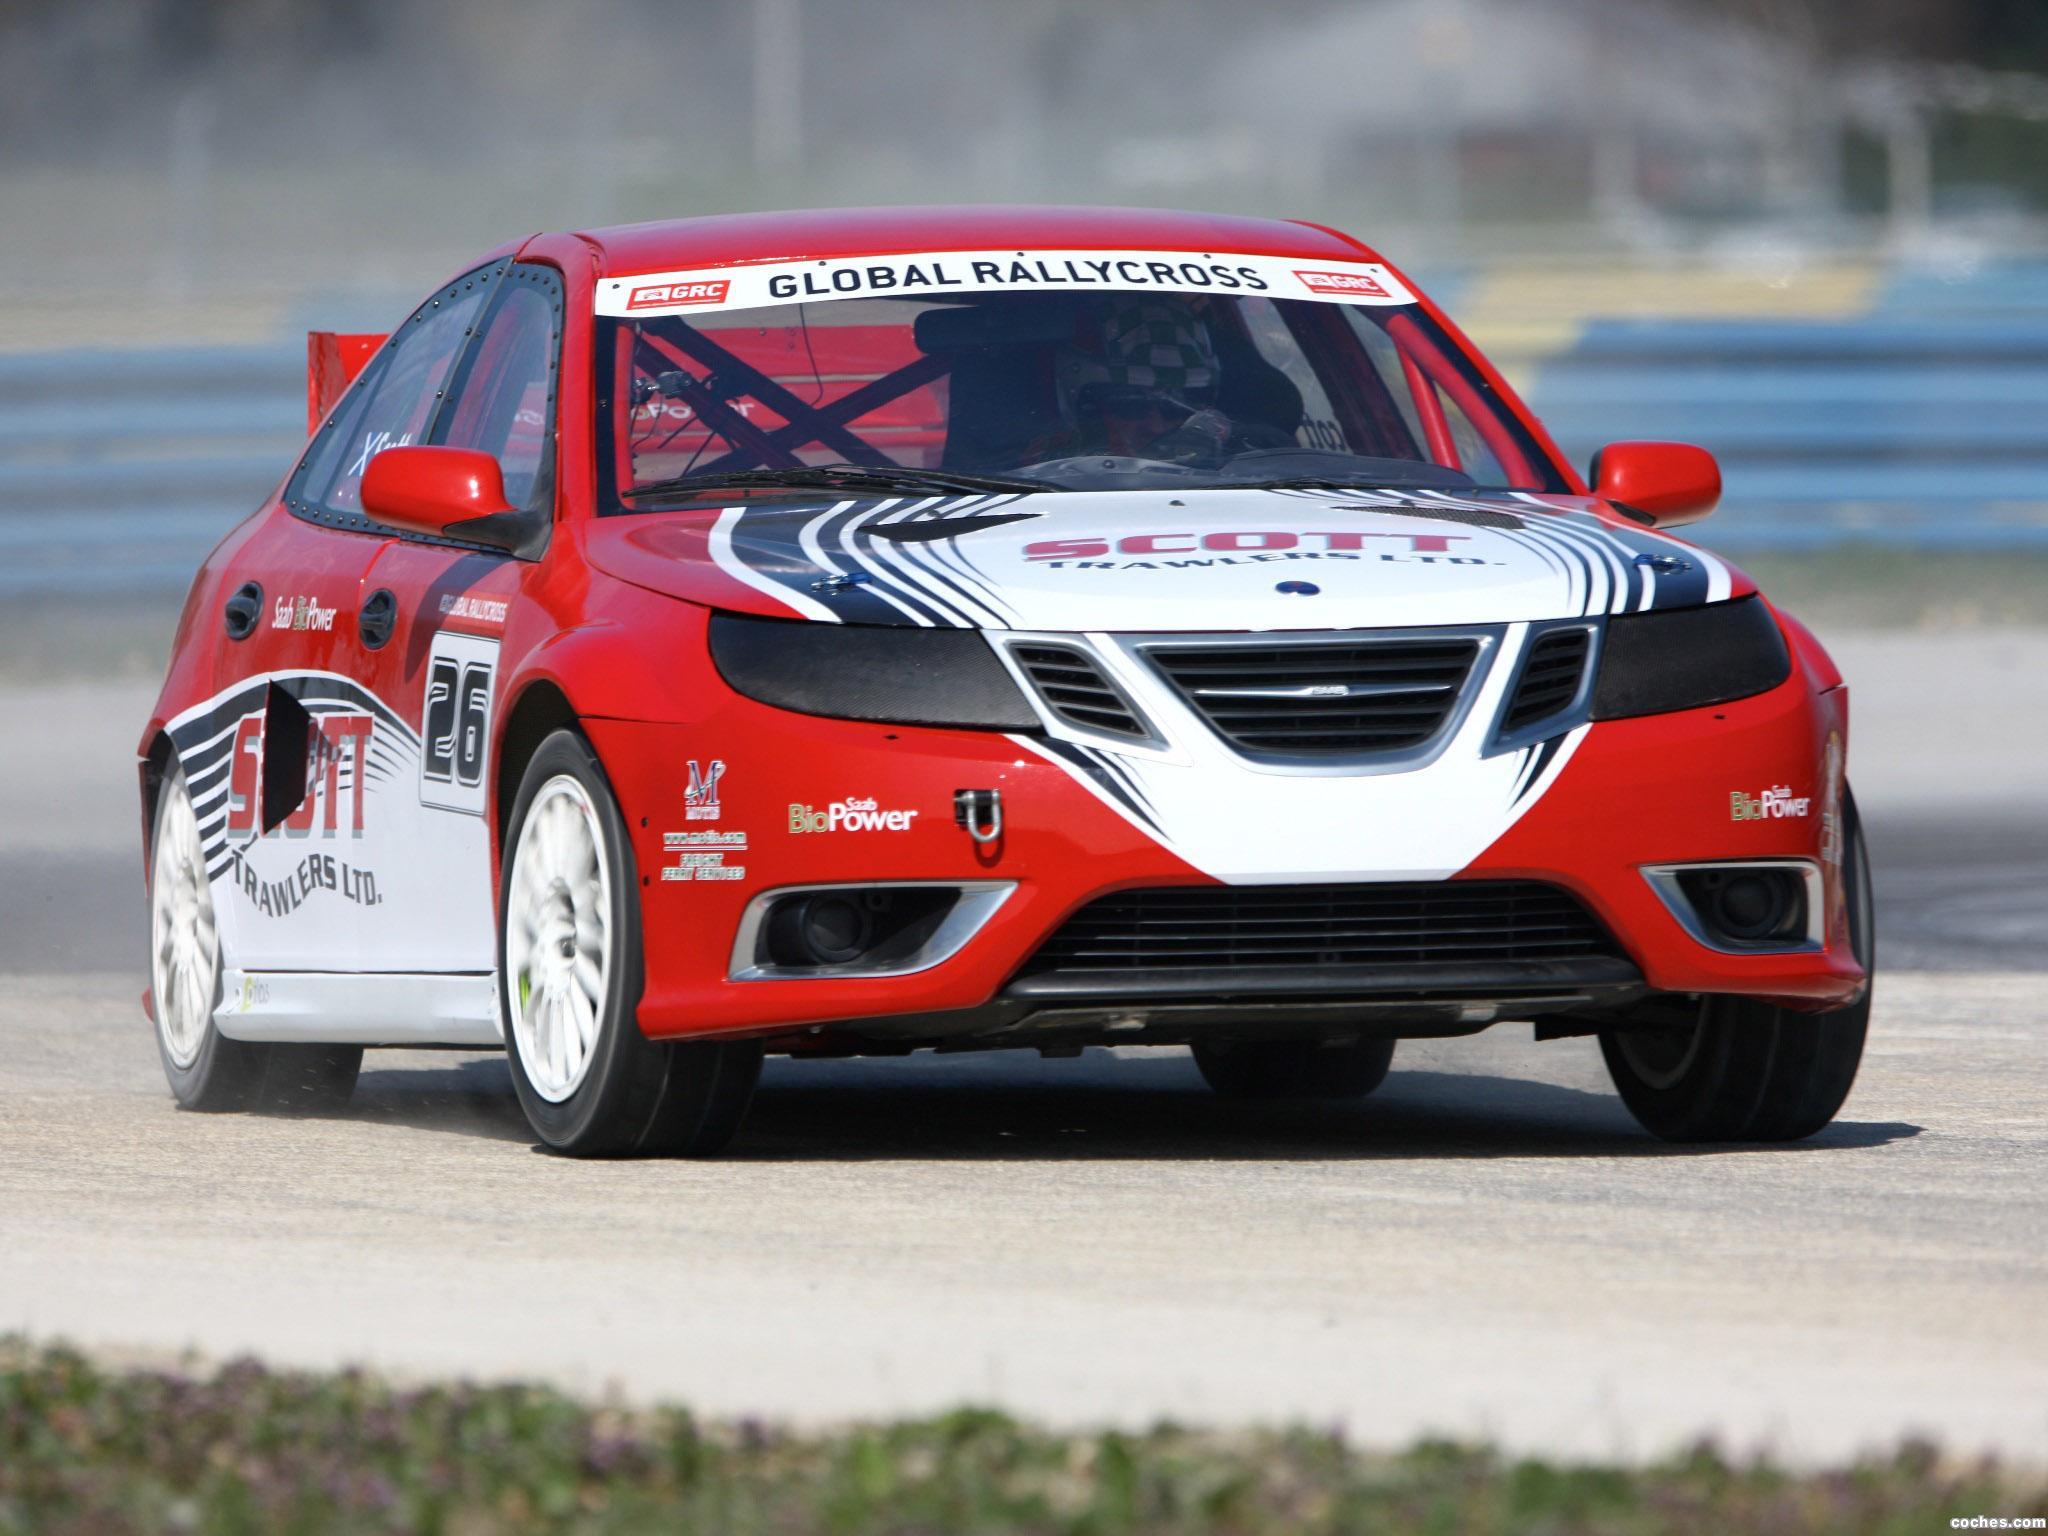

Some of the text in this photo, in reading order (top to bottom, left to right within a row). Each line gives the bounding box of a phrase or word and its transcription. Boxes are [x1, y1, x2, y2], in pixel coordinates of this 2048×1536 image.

[671, 283, 724, 299] GRC
[769, 261, 1268, 298] GLOBAL RALLYCROSS
[1022, 532, 1472, 561] SCOTT
[1041, 552, 1507, 569] TRAWLERS LTD.
[272, 595, 337, 631] Saab BioPower
[423, 656, 491, 788] 26
[226, 714, 375, 839] SOTT
[1772, 784, 1792, 798] Saab
[788, 803, 918, 833] BioPower
[846, 797, 878, 811] Saab
[1730, 790, 1811, 820] BioPower
[232, 849, 382, 918] TRAWLERS LTD.
